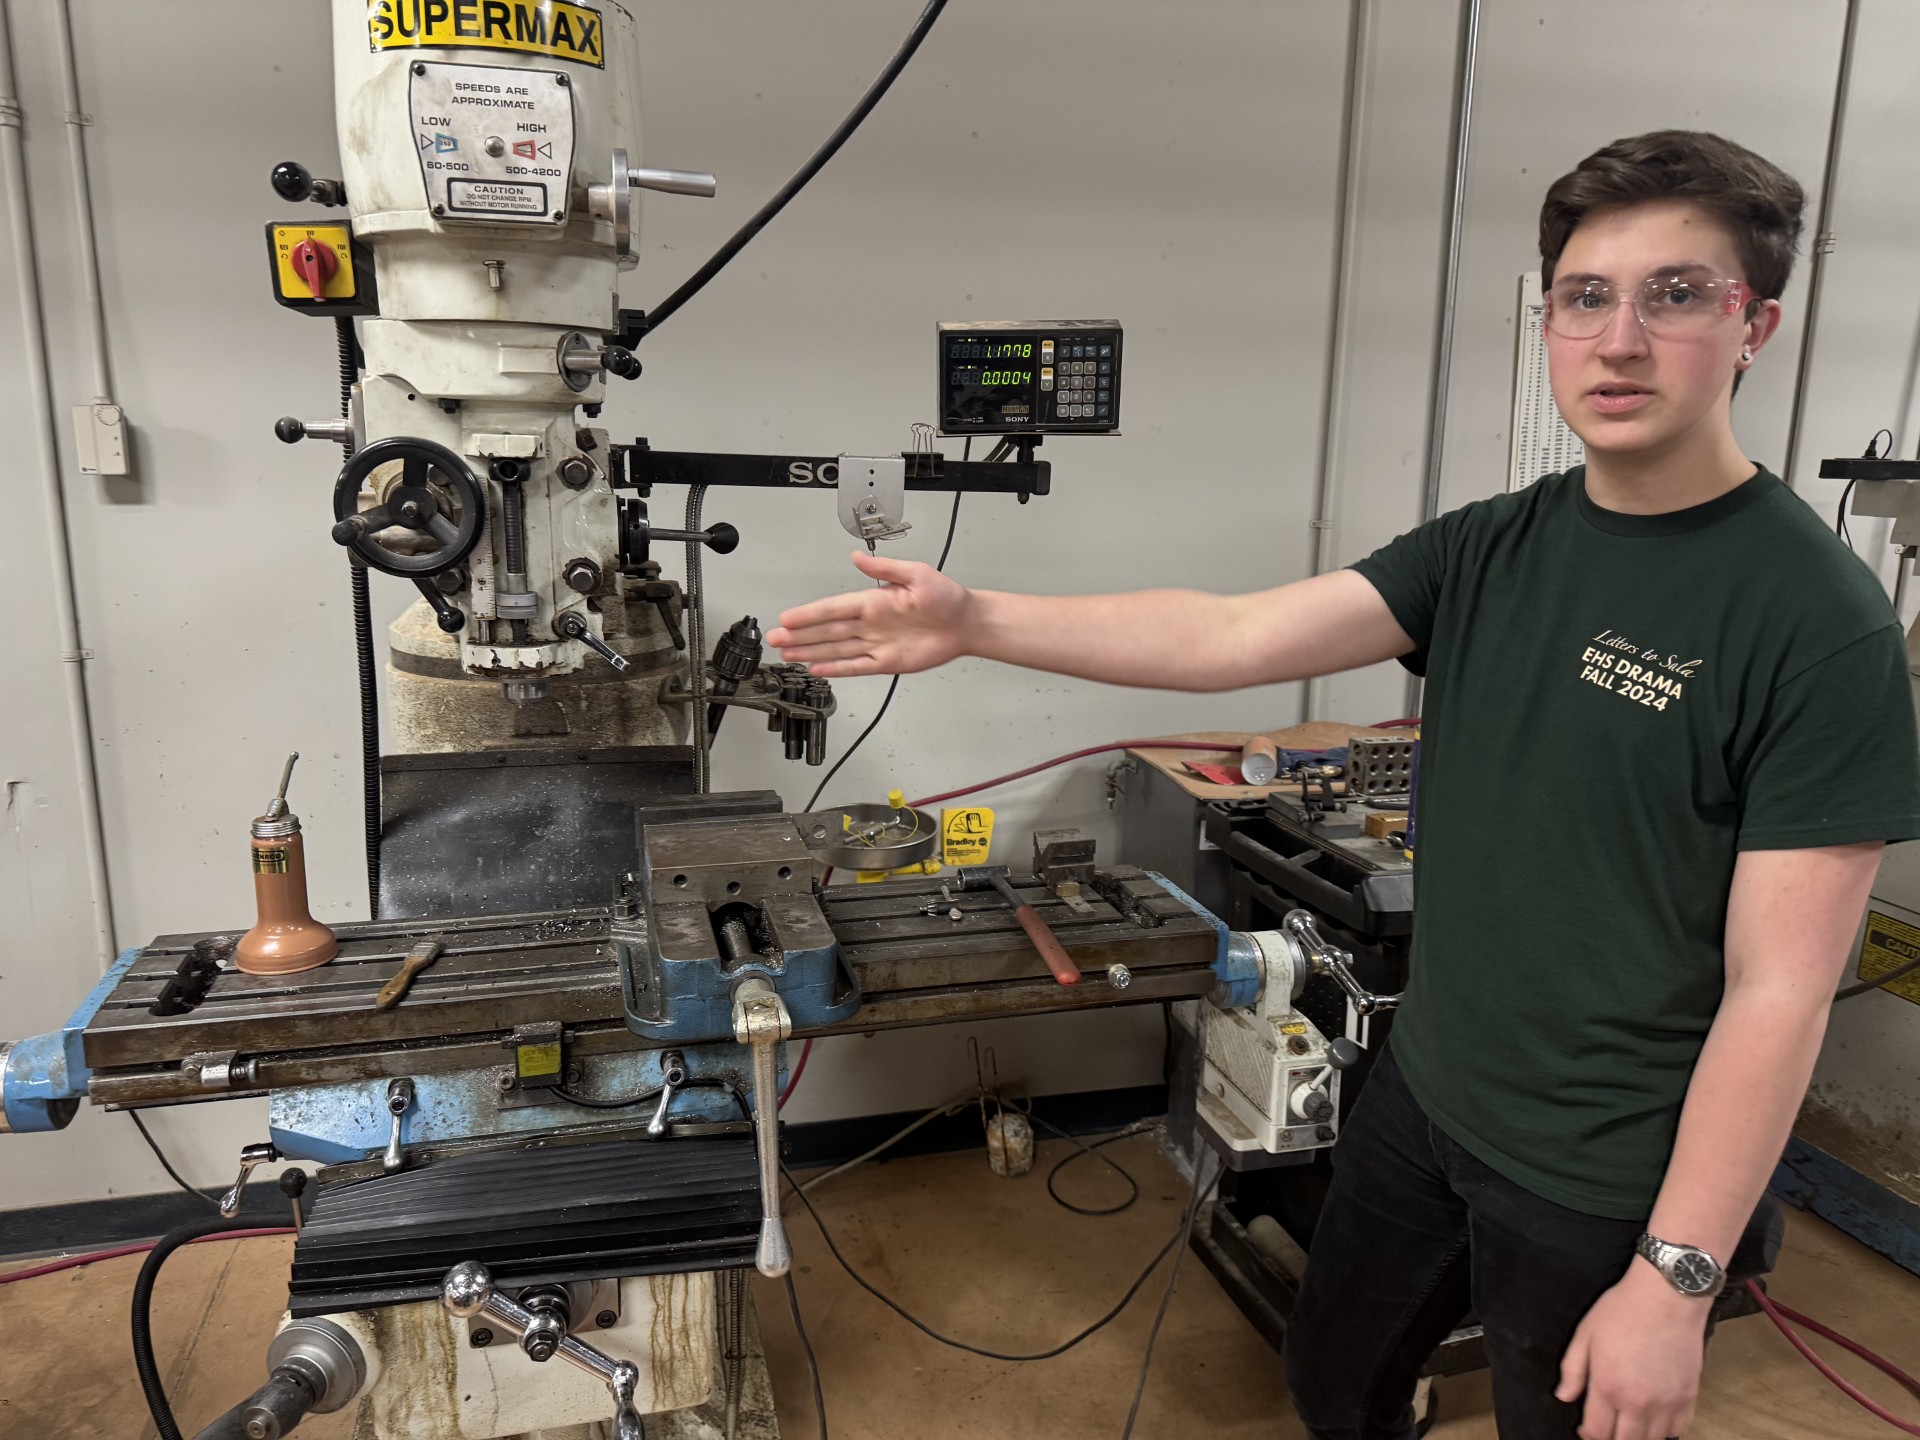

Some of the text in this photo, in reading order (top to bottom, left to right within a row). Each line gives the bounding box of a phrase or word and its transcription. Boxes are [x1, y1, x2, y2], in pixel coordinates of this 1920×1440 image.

[373, 0, 599, 57] SUPERMAX
[455, 82, 529, 96] SPEEDS ARE
[451, 96, 535, 110] APPROXIMATE
[421, 116, 451, 128] LOW
[516, 122, 547, 133] HIGH
[426, 161, 469, 171] 60-500
[505, 166, 562, 177] 500-4200
[474, 185, 524, 195] CAUTION
[987, 344, 1032, 358] 1.1778
[981, 371, 1031, 385] 0.0004
[788, 461, 839, 485] SO
[1592, 629, 1703, 679] Letters to Sala
[1581, 646, 1683, 700] EHS DRAMA
[1580, 665, 1669, 712] FALL 2024
[946, 838, 977, 847] Bradley
[1886, 938, 1920, 960] CAUTI
